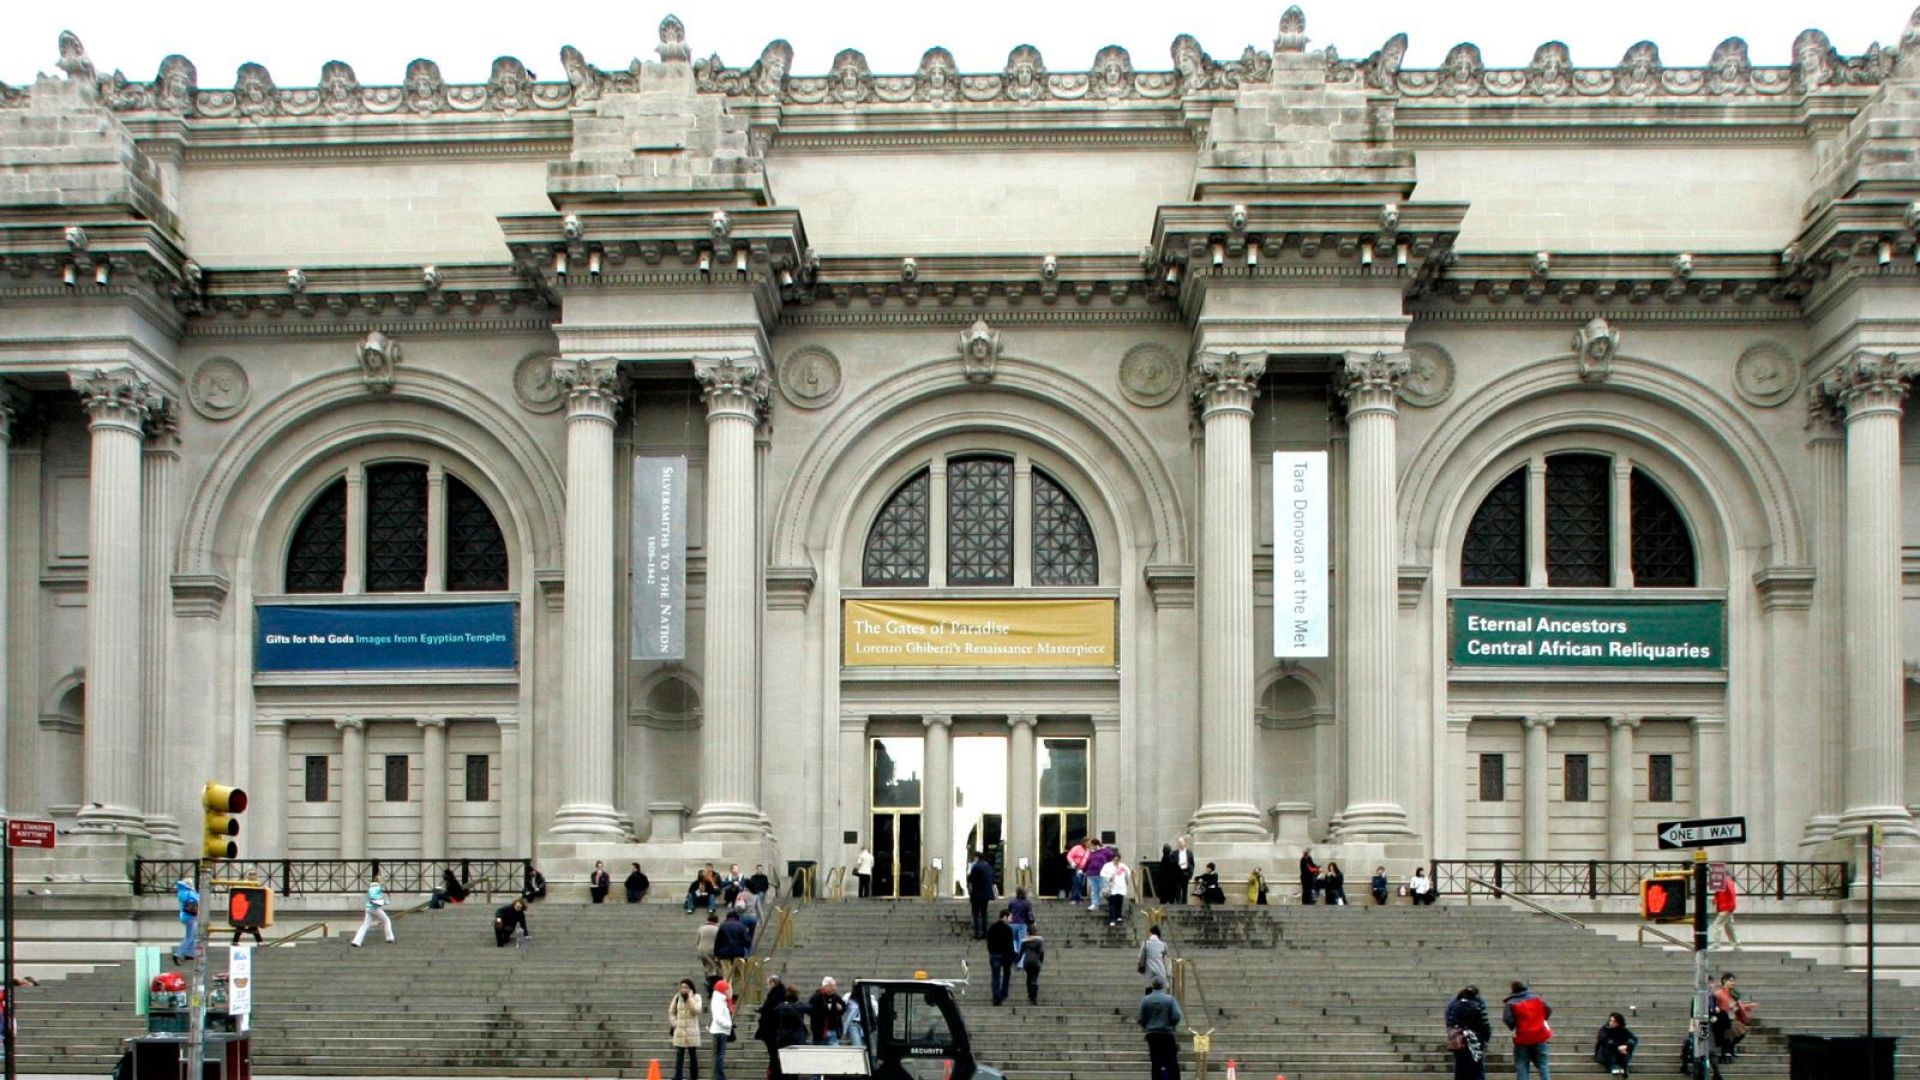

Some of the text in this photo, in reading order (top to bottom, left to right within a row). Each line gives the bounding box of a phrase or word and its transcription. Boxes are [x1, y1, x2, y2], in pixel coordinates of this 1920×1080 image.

[660, 552, 670, 570] TO
[1293, 461, 1308, 648] Tara Donovan at the Met
[660, 575, 670, 599] THE
[660, 604, 672, 653] NATION
[853, 619, 1009, 635] The Gates of Paradise
[1468, 616, 1627, 634] Eternal Ancestors
[266, 632, 506, 645] Gifts for the Gods Images from Egyptian Temples
[856, 641, 902, 653] Lorenzo
[965, 642, 1033, 653] Renaissance
[1037, 642, 1105, 656] Masterpiece
[1467, 640, 1710, 660] Central African Reliquaries
[1669, 826, 1735, 841] ONE WAY
